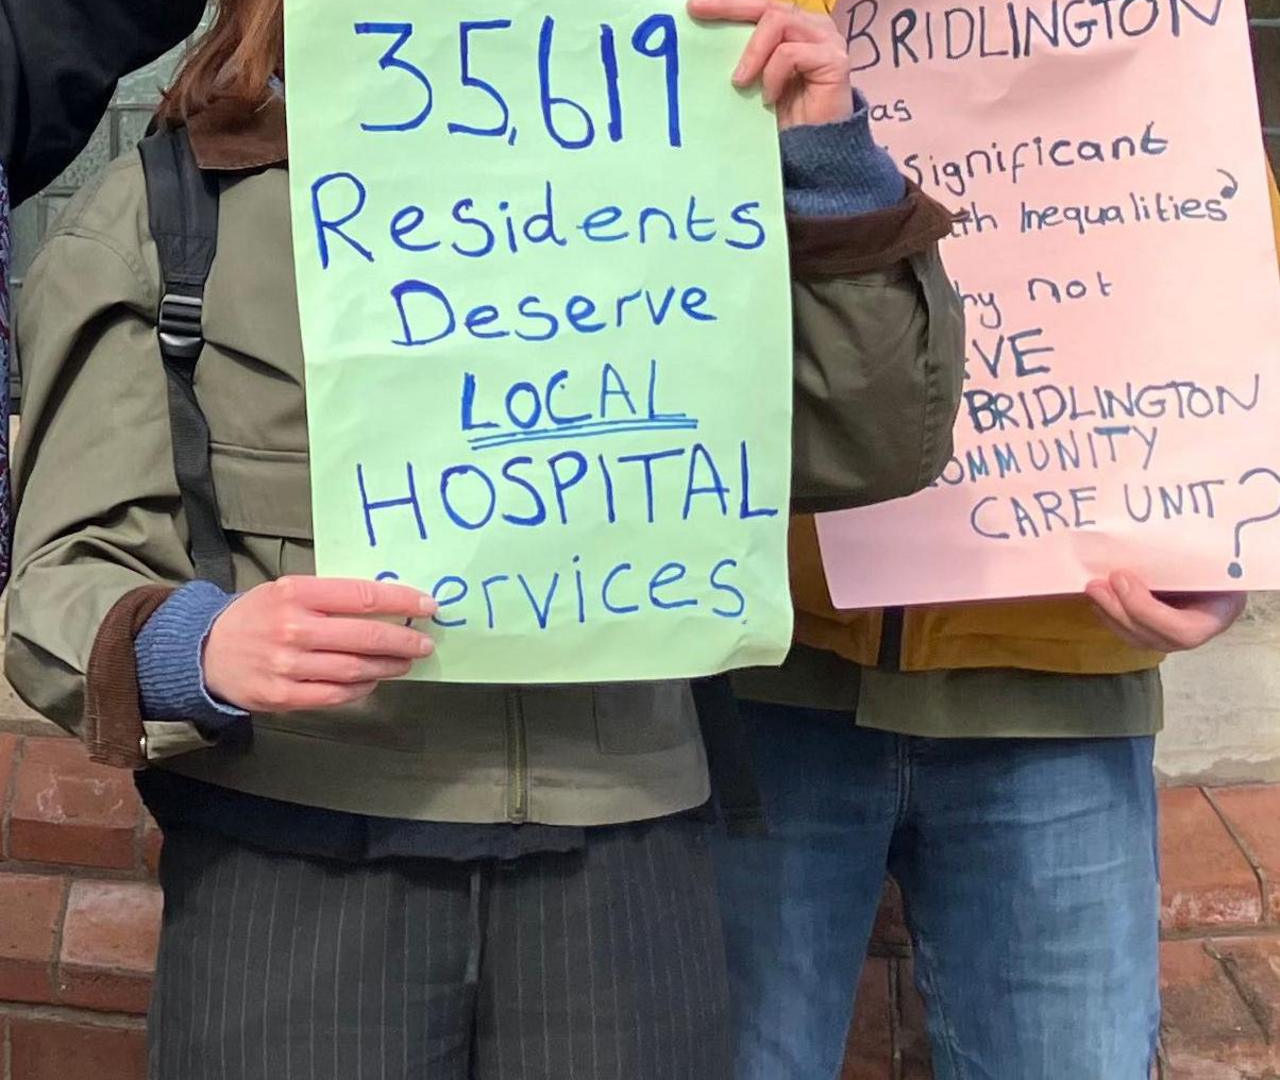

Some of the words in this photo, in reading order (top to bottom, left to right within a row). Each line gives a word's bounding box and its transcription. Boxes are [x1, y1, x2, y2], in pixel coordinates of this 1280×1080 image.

[351, 12, 683, 151] 35,619
[870, 99, 913, 122] as
[308, 171, 768, 270] Residents
[389, 278, 719, 347] Deserve
[1027, 271, 1113, 304] not
[459, 358, 688, 432] LOCAL
[963, 373, 1260, 434] BRIDLINGTON
[928, 424, 1158, 487] OMMUNITY
[356, 440, 780, 549] HOSPITAL
[970, 486, 1097, 539] CARE
